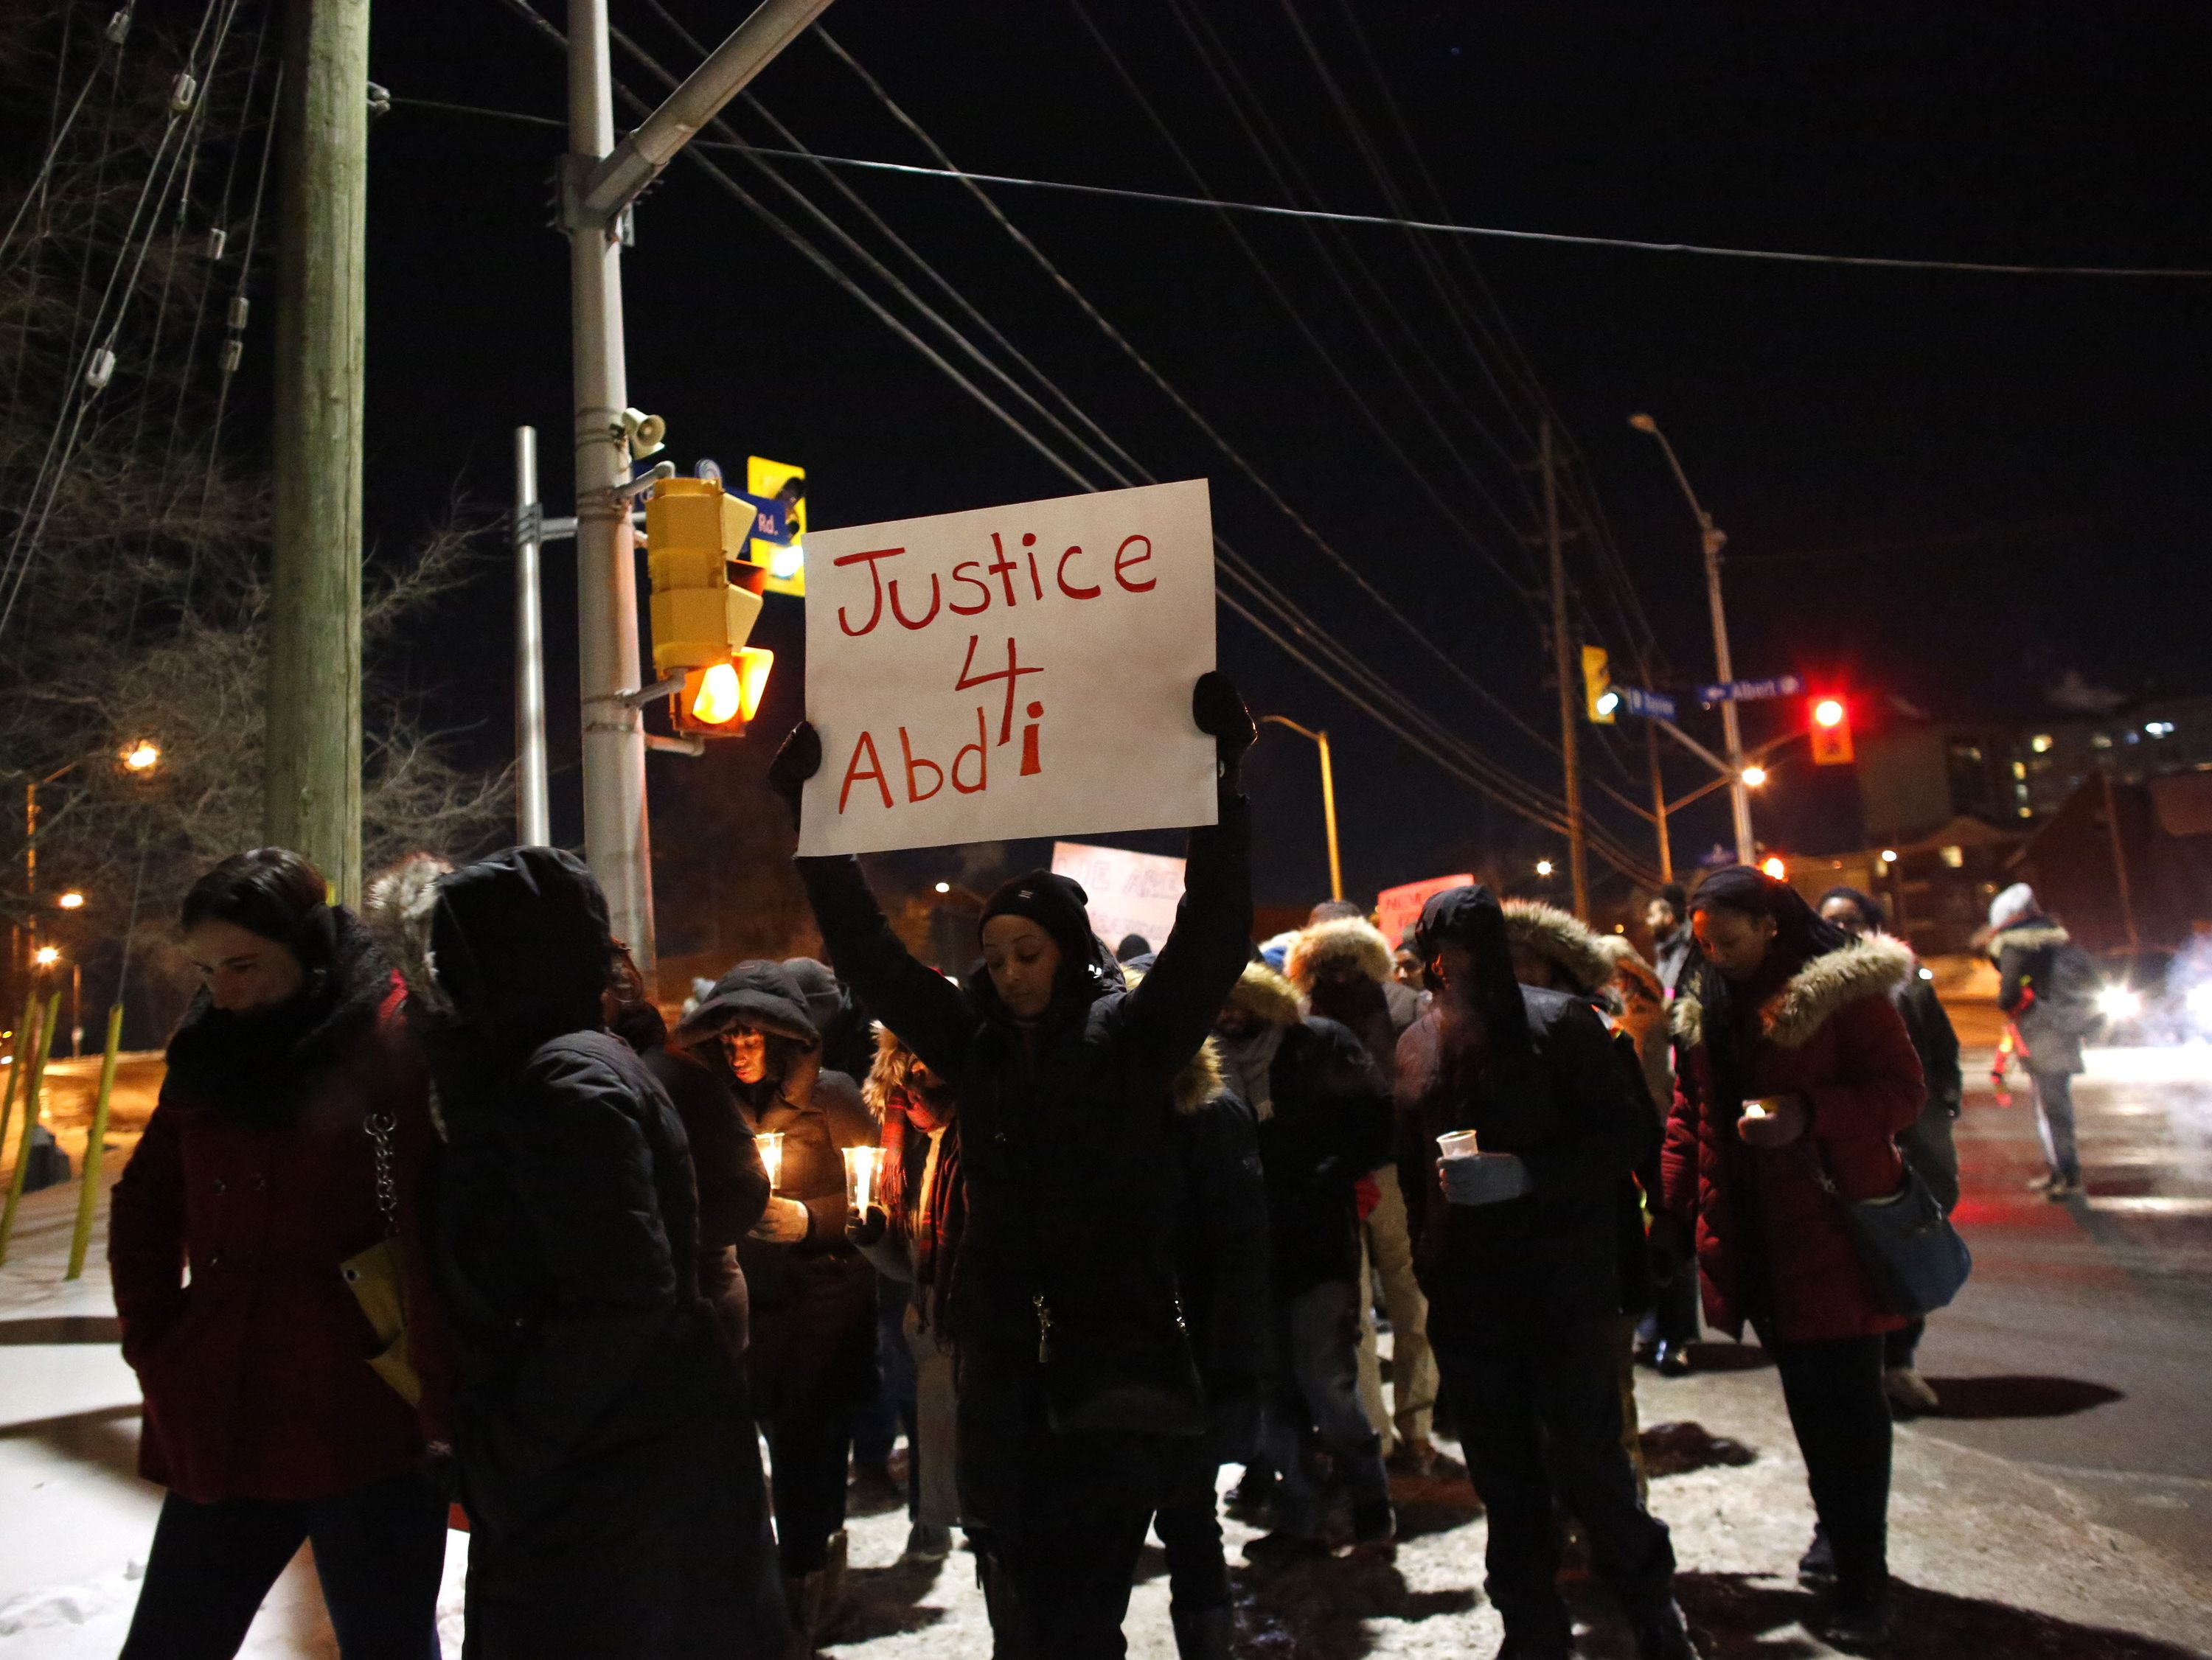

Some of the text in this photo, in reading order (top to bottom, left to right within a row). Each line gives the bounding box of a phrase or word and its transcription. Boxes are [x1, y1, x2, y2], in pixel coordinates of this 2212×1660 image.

[757, 512, 779, 537] Rd.
[833, 532, 1157, 636] Justice
[955, 634, 1044, 747] 4
[838, 700, 1044, 815] Abdi
